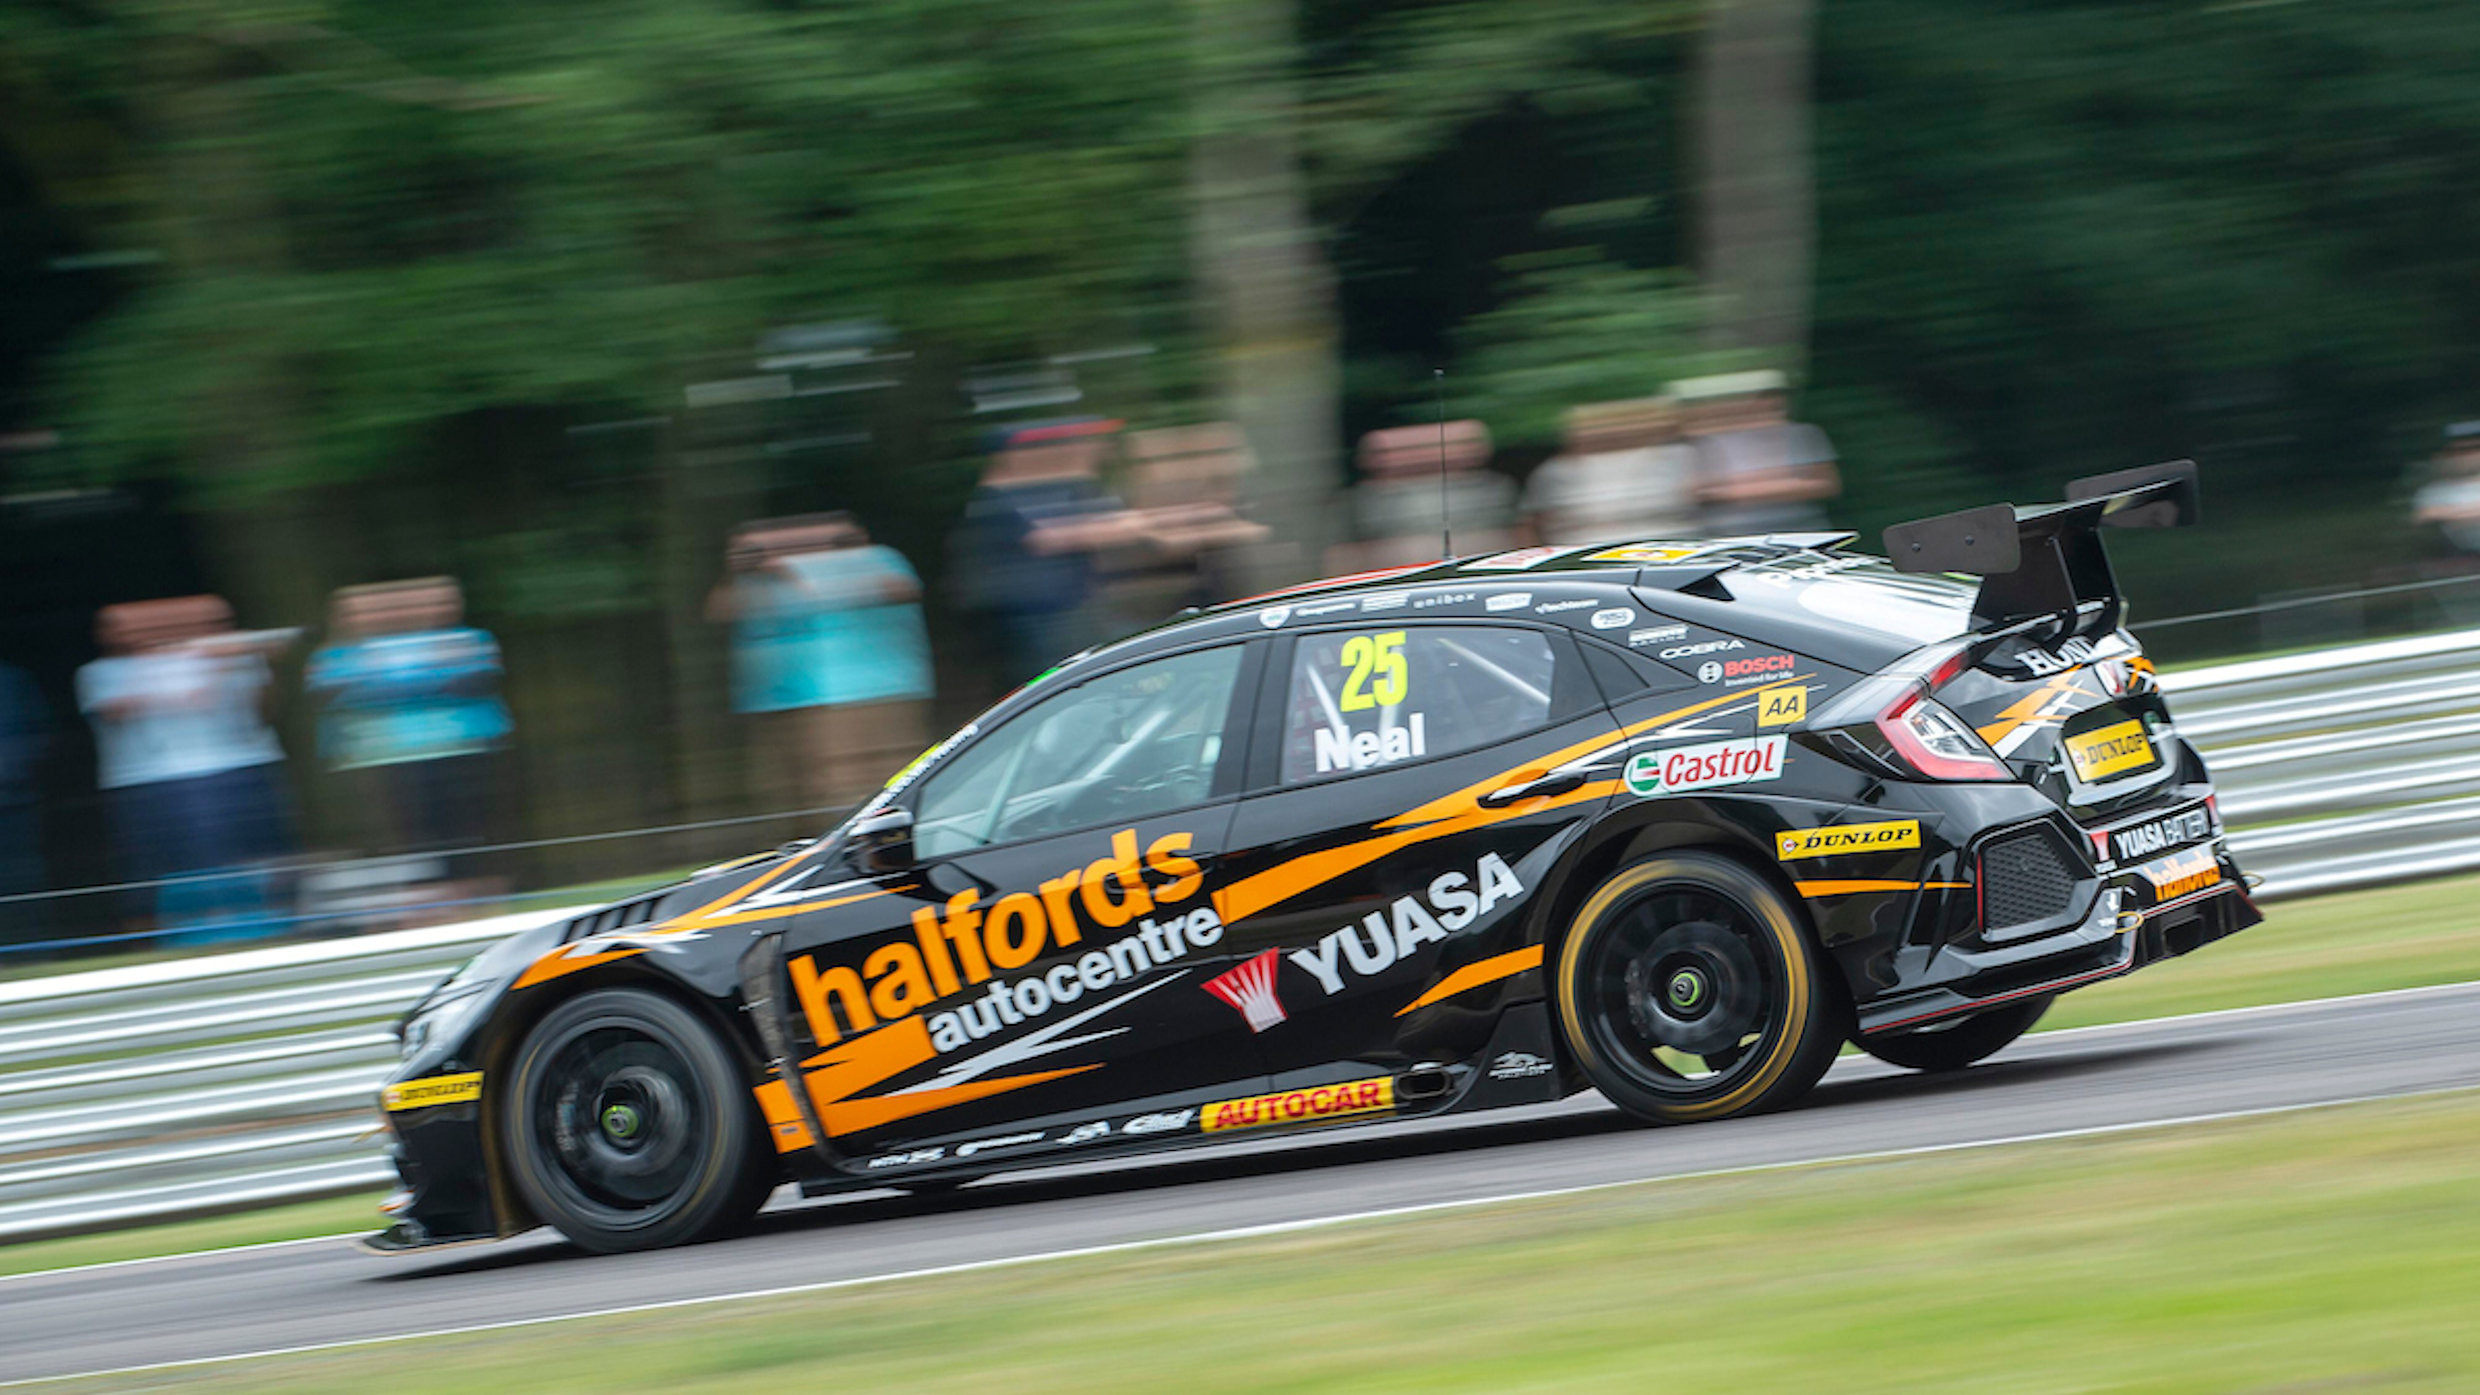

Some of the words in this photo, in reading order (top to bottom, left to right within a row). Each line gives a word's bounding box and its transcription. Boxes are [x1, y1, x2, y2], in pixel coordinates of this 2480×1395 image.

[1339, 630, 1408, 712] 25
[1659, 639, 1746, 660] COBRA
[1724, 654, 1795, 677] BOSCH
[1765, 694, 1799, 718] AA
[1314, 712, 1427, 773] Neal
[1664, 741, 1775, 786] Castrol
[2087, 732, 2144, 765] DUNLOP
[1802, 827, 1913, 850] DUNLOP
[2114, 821, 2167, 860] YUASA
[788, 828, 1204, 1048] halfords
[1288, 850, 1524, 996] YUASA
[926, 906, 1224, 1054] autocentre
[1213, 1081, 1382, 1130] AUTOCAR
